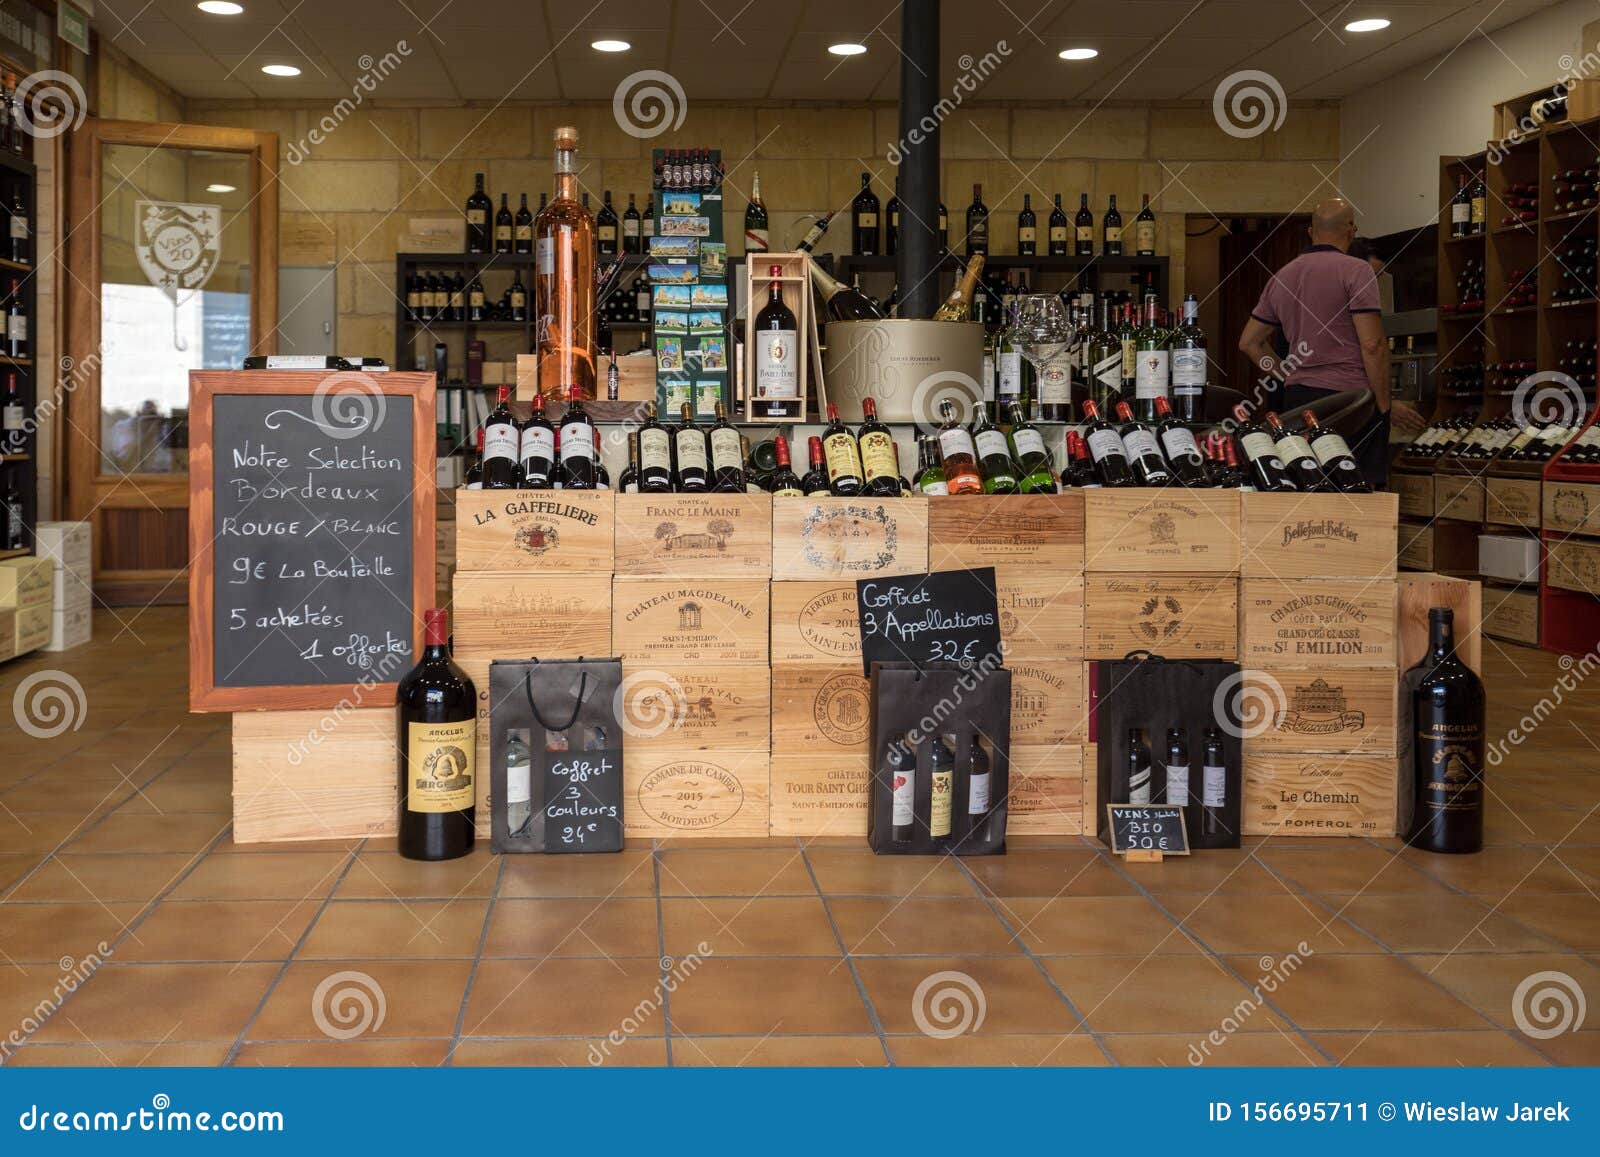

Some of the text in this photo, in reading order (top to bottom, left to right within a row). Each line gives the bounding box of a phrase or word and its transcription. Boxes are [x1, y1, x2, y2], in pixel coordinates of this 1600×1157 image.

[169, 248, 194, 264] 20
[233, 440, 401, 470] Notre Selection
[230, 473, 380, 501] Bordeaux
[473, 501, 599, 527] LA GAFFELIERE
[646, 506, 742, 517] FRANC LE MAINE
[222, 518, 300, 535] ROUGE
[331, 518, 401, 535] BLANC
[229, 556, 395, 584] 9€ La Bouteille
[625, 589, 754, 622] CHÂTEAU MAGDELAINE
[804, 591, 856, 617] TERTRE RO
[863, 583, 931, 608] Coffret
[229, 605, 344, 629] 5 achetées
[1270, 595, 1313, 623] CHATEAU
[1325, 595, 1368, 623] GEORGES
[835, 619, 860, 628] 2012
[865, 609, 994, 642] 3 Appellations
[300, 631, 404, 665] 1 offerte
[806, 628, 862, 652] SAINT-EM
[1296, 641, 1363, 654] EMILION
[926, 640, 980, 662] 32€
[698, 684, 743, 705] TAYAC
[551, 759, 613, 782] Coffret
[644, 765, 739, 793] DOMAINE DE CAMBES
[565, 786, 581, 799] 3
[676, 792, 703, 801] 2015
[785, 782, 814, 794] TOUR
[816, 782, 846, 794] SAINT
[1280, 791, 1360, 803] Le Chemin
[792, 801, 854, 809] SAINT-EMILION
[1114, 809, 1150, 819] VINS
[660, 811, 720, 826] BORDEAUX
[1129, 821, 1163, 833] BIO
[1285, 820, 1353, 829] POMEROL
